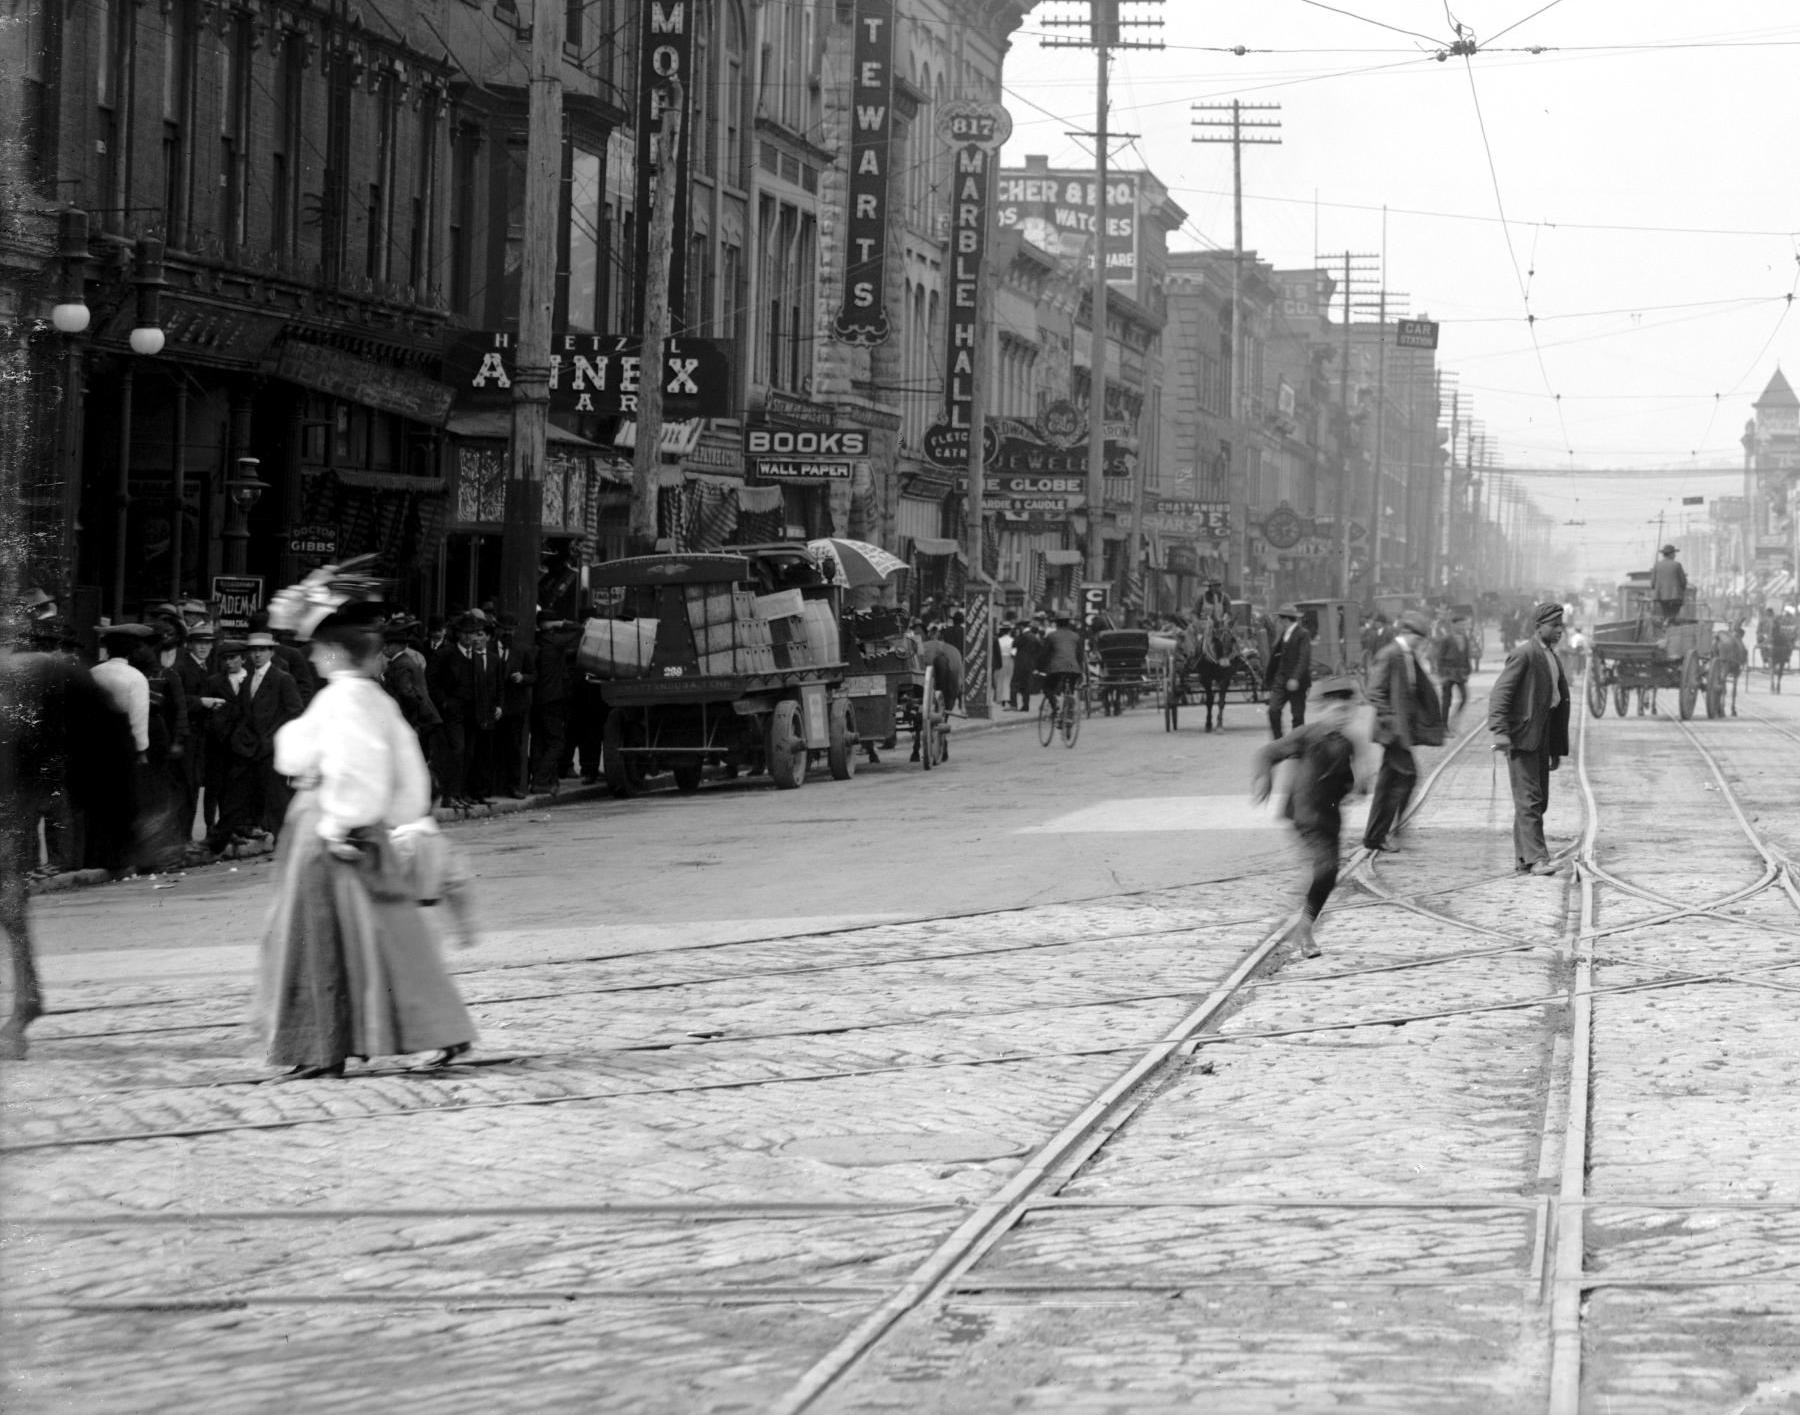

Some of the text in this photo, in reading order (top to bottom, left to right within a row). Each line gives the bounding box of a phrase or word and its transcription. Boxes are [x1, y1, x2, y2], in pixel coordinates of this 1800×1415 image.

[952, 117, 995, 136] 817
[998, 179, 1059, 203] CHER
[1065, 182, 1083, 205] &
[957, 148, 984, 307] MARBLE
[1405, 323, 1431, 335] CAR
[951, 323, 975, 429] HALL
[748, 432, 865, 453] BOOKS
[759, 463, 850, 478] WALL PAPER
[958, 478, 1081, 493] TE GLOBE
[981, 498, 1012, 510] ARDIE
[1023, 499, 1066, 511] CAUDLE
[292, 525, 337, 539] DOCTOR
[290, 540, 337, 554] GIBBS
